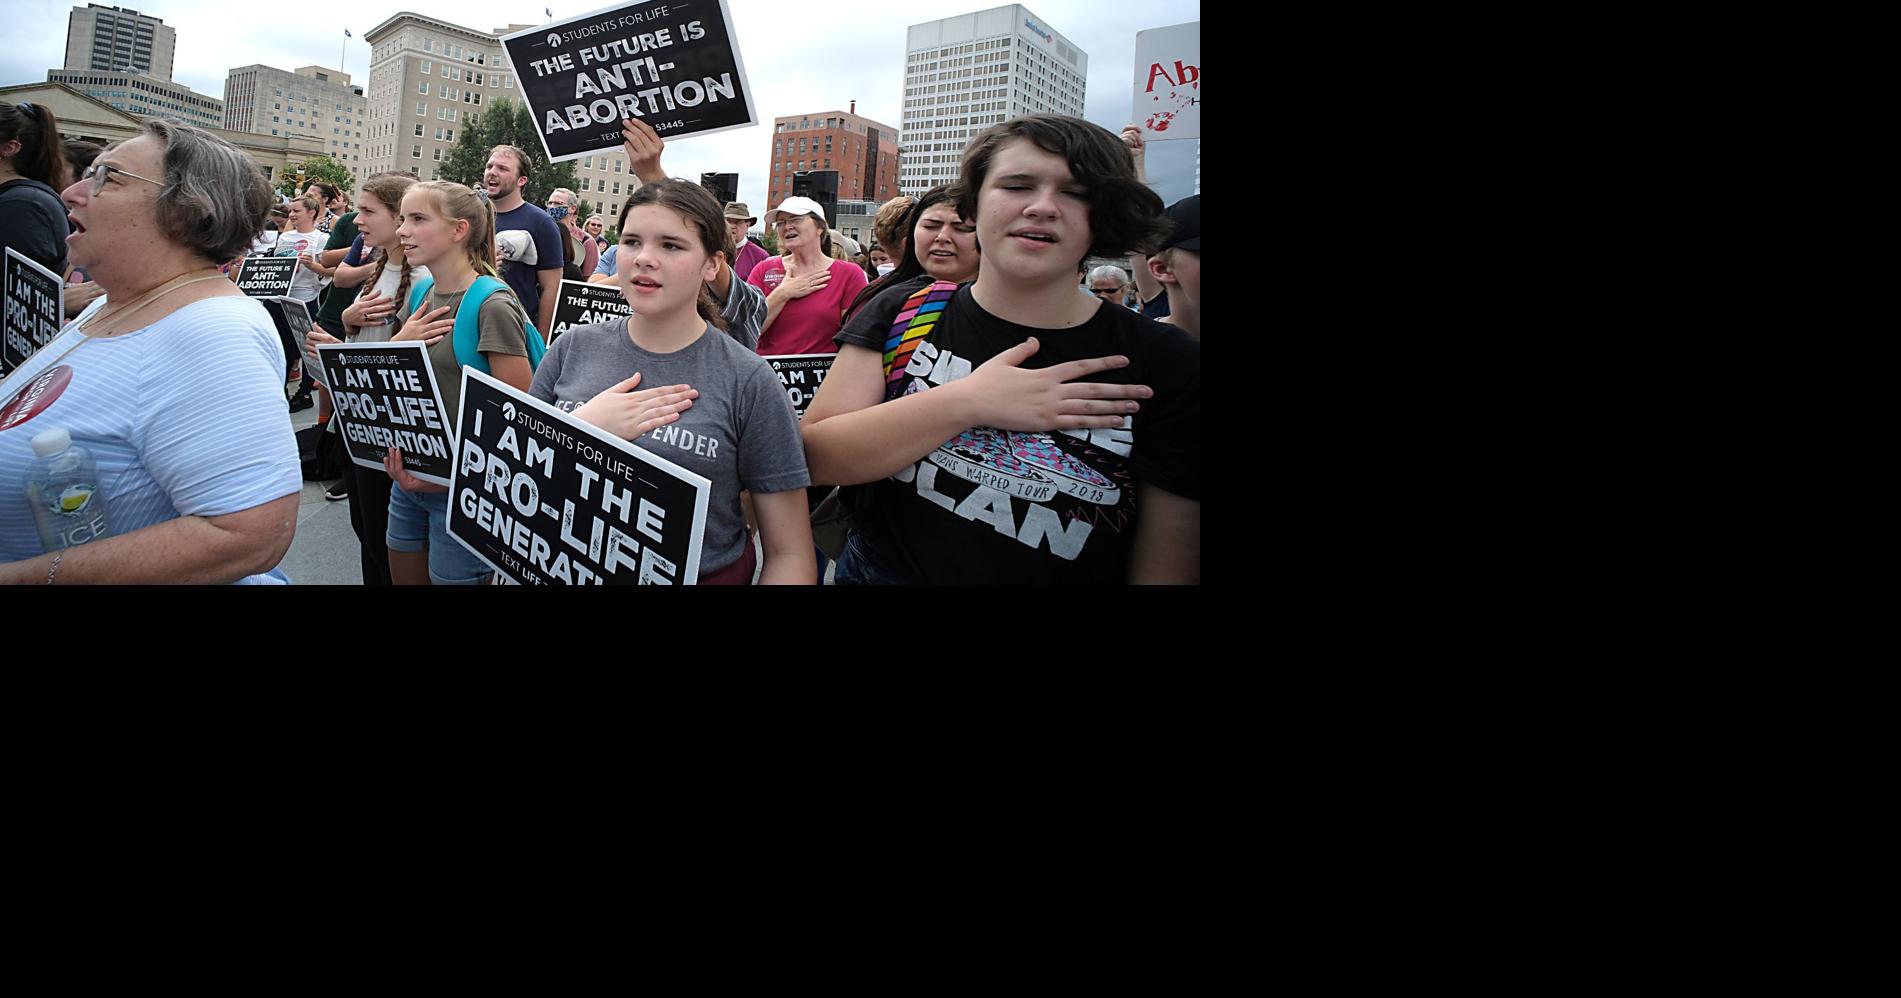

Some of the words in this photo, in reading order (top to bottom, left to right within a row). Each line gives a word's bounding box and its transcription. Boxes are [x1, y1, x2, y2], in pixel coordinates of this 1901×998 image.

[562, 19, 617, 42] STUDENTS
[618, 13, 644, 28] FOR
[645, 5, 670, 21] LIFE
[529, 53, 575, 77] THE
[578, 28, 674, 66] FUTURE
[679, 20, 706, 42] IS
[575, 56, 675, 99] ANTI-
[1145, 60, 1200, 93] Ab
[545, 72, 736, 135] ABORTION
[600, 131, 620, 142] TEXT
[655, 119, 684, 132] 53445
[238, 280, 290, 289] ABORTION
[251, 271, 280, 281] ANTI-
[589, 289, 616, 299] STUDENTS
[9, 273, 13, 292] I
[15, 278, 31, 305] AM
[34, 289, 56, 321] THE
[567, 296, 589, 307] THE
[346, 355, 373, 364] STUDENTS
[373, 355, 387, 365] FOR
[386, 355, 400, 365] LIFE
[781, 361, 811, 369] STUDENTS
[330, 367, 339, 386] I
[345, 368, 373, 388] AM
[377, 369, 423, 392] THE
[333, 391, 442, 429] PRO-LIFE
[346, 422, 448, 459] GENERATION
[517, 411, 573, 450] STUDENTS
[576, 441, 603, 465] FOR
[606, 456, 634, 482] LIFE
[474, 408, 483, 437] I
[496, 427, 555, 479] AM
[575, 462, 666, 544] THE
[935, 453, 959, 472] VANS
[965, 465, 1010, 490] WARPED
[1017, 483, 1050, 499] TOUR
[460, 438, 677, 585] PRO-LIFE
[891, 460, 1094, 561] LAN
[60, 513, 106, 547] ICE
[501, 551, 520, 573] TEXT
[522, 567, 541, 585] LIFE
